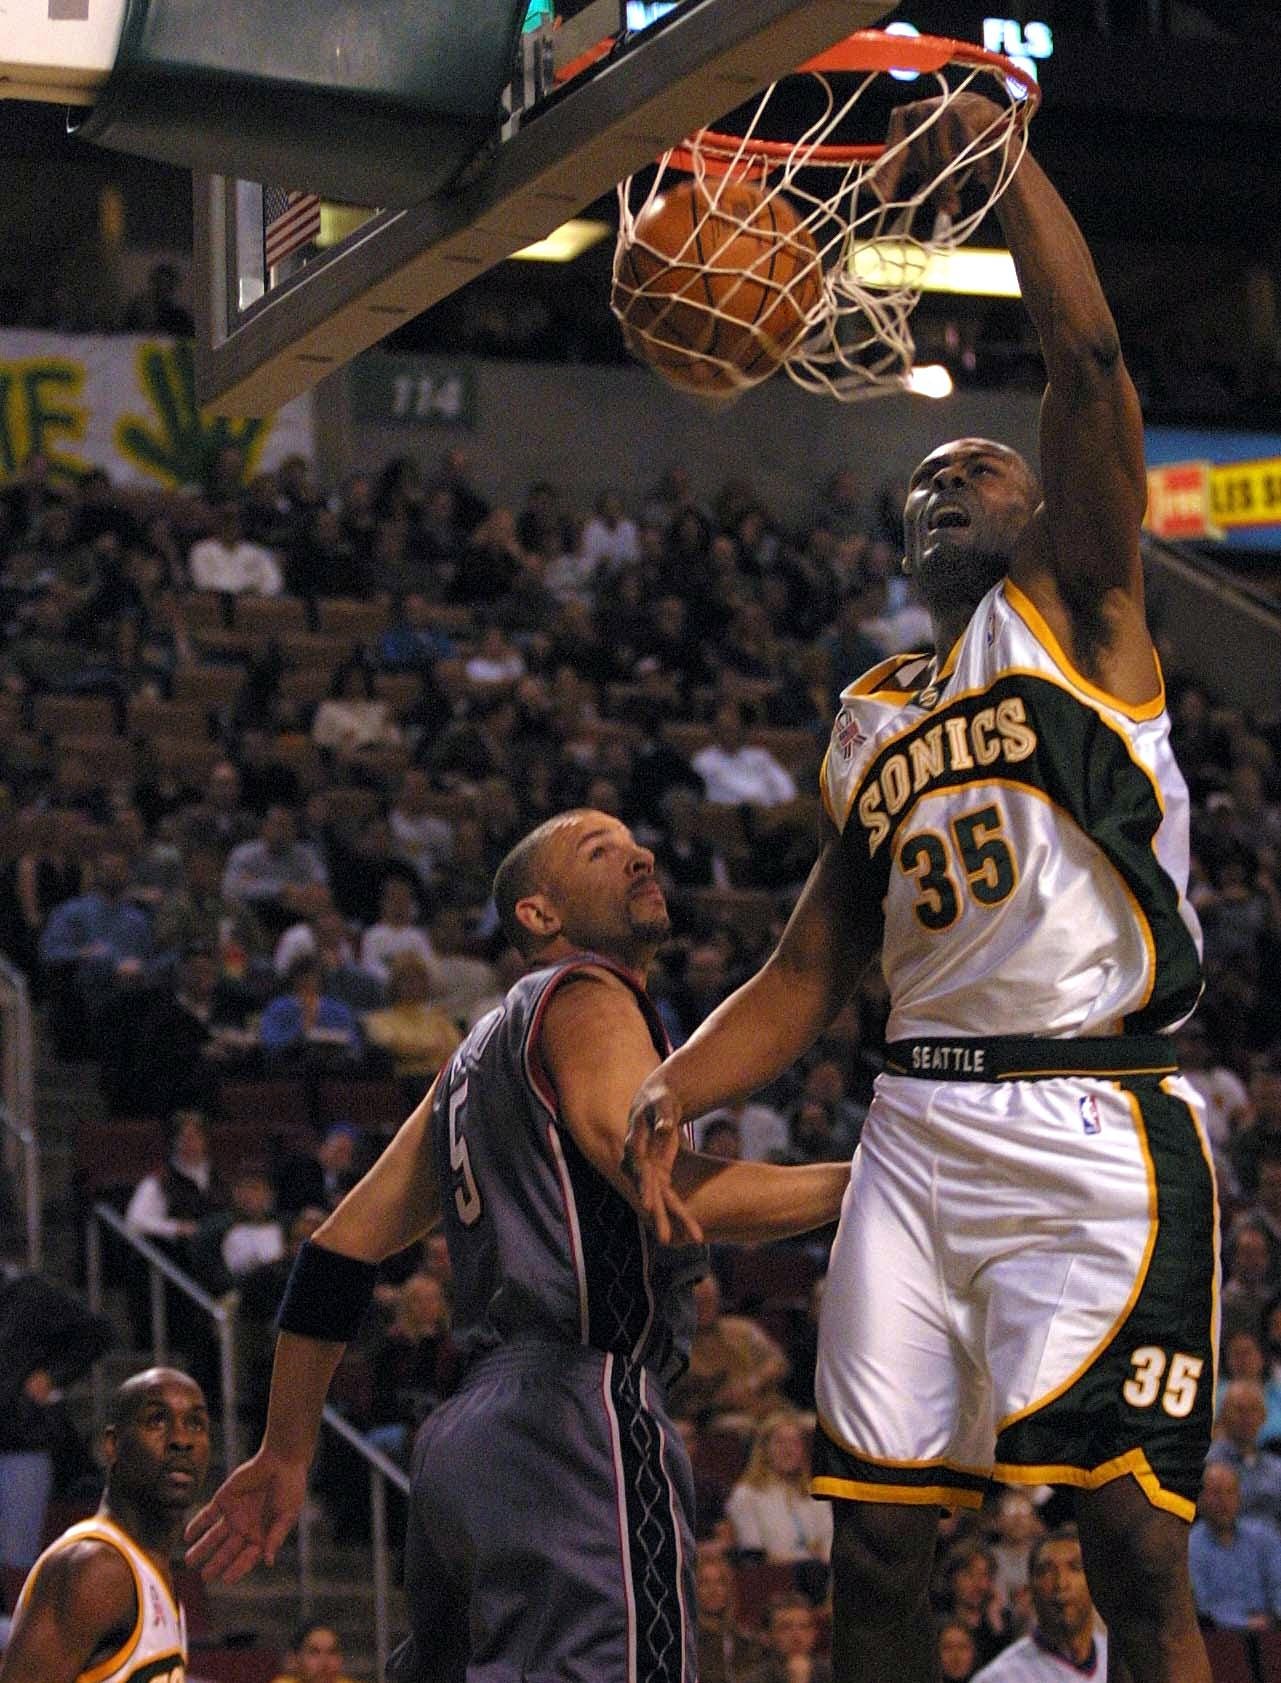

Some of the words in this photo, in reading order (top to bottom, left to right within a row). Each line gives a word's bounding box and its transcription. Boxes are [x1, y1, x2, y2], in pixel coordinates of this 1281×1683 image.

[983, 18, 1053, 58] FLS
[390, 375, 462, 417] 114
[858, 697, 1037, 859] SONICS
[899, 803, 1020, 931] 35
[912, 1045, 985, 1072] SEATTLE
[448, 1078, 482, 1226] 5
[1123, 1345, 1204, 1418] 35
